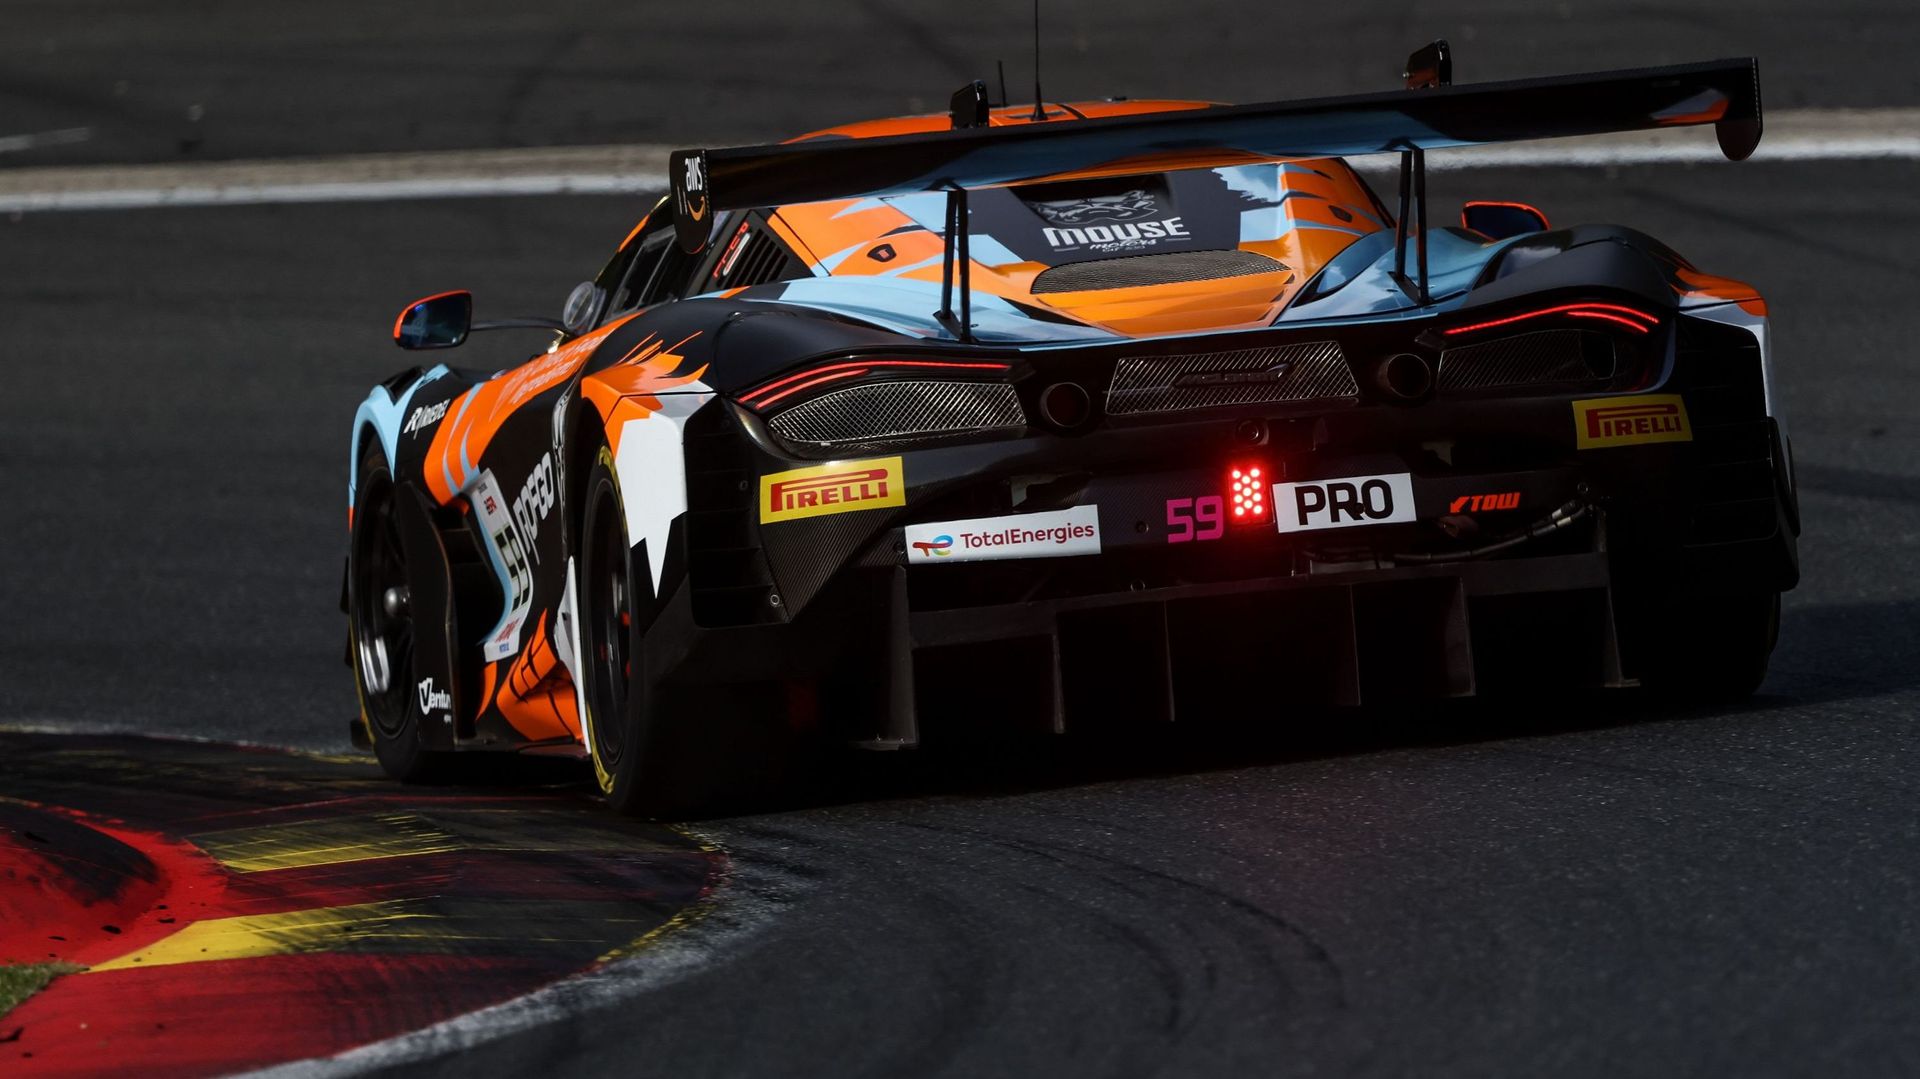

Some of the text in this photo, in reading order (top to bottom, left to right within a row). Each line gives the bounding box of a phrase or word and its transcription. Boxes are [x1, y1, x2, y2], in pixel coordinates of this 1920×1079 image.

[684, 156, 702, 192] aws
[1042, 217, 1190, 247] MOUSE
[1586, 404, 1682, 438] PIRELLI
[770, 468, 888, 513] PIRELLI
[1295, 479, 1393, 525] PRO
[1470, 491, 1521, 512] TOW
[960, 523, 1095, 549] TotalEnergies
[1165, 495, 1225, 544] 59
